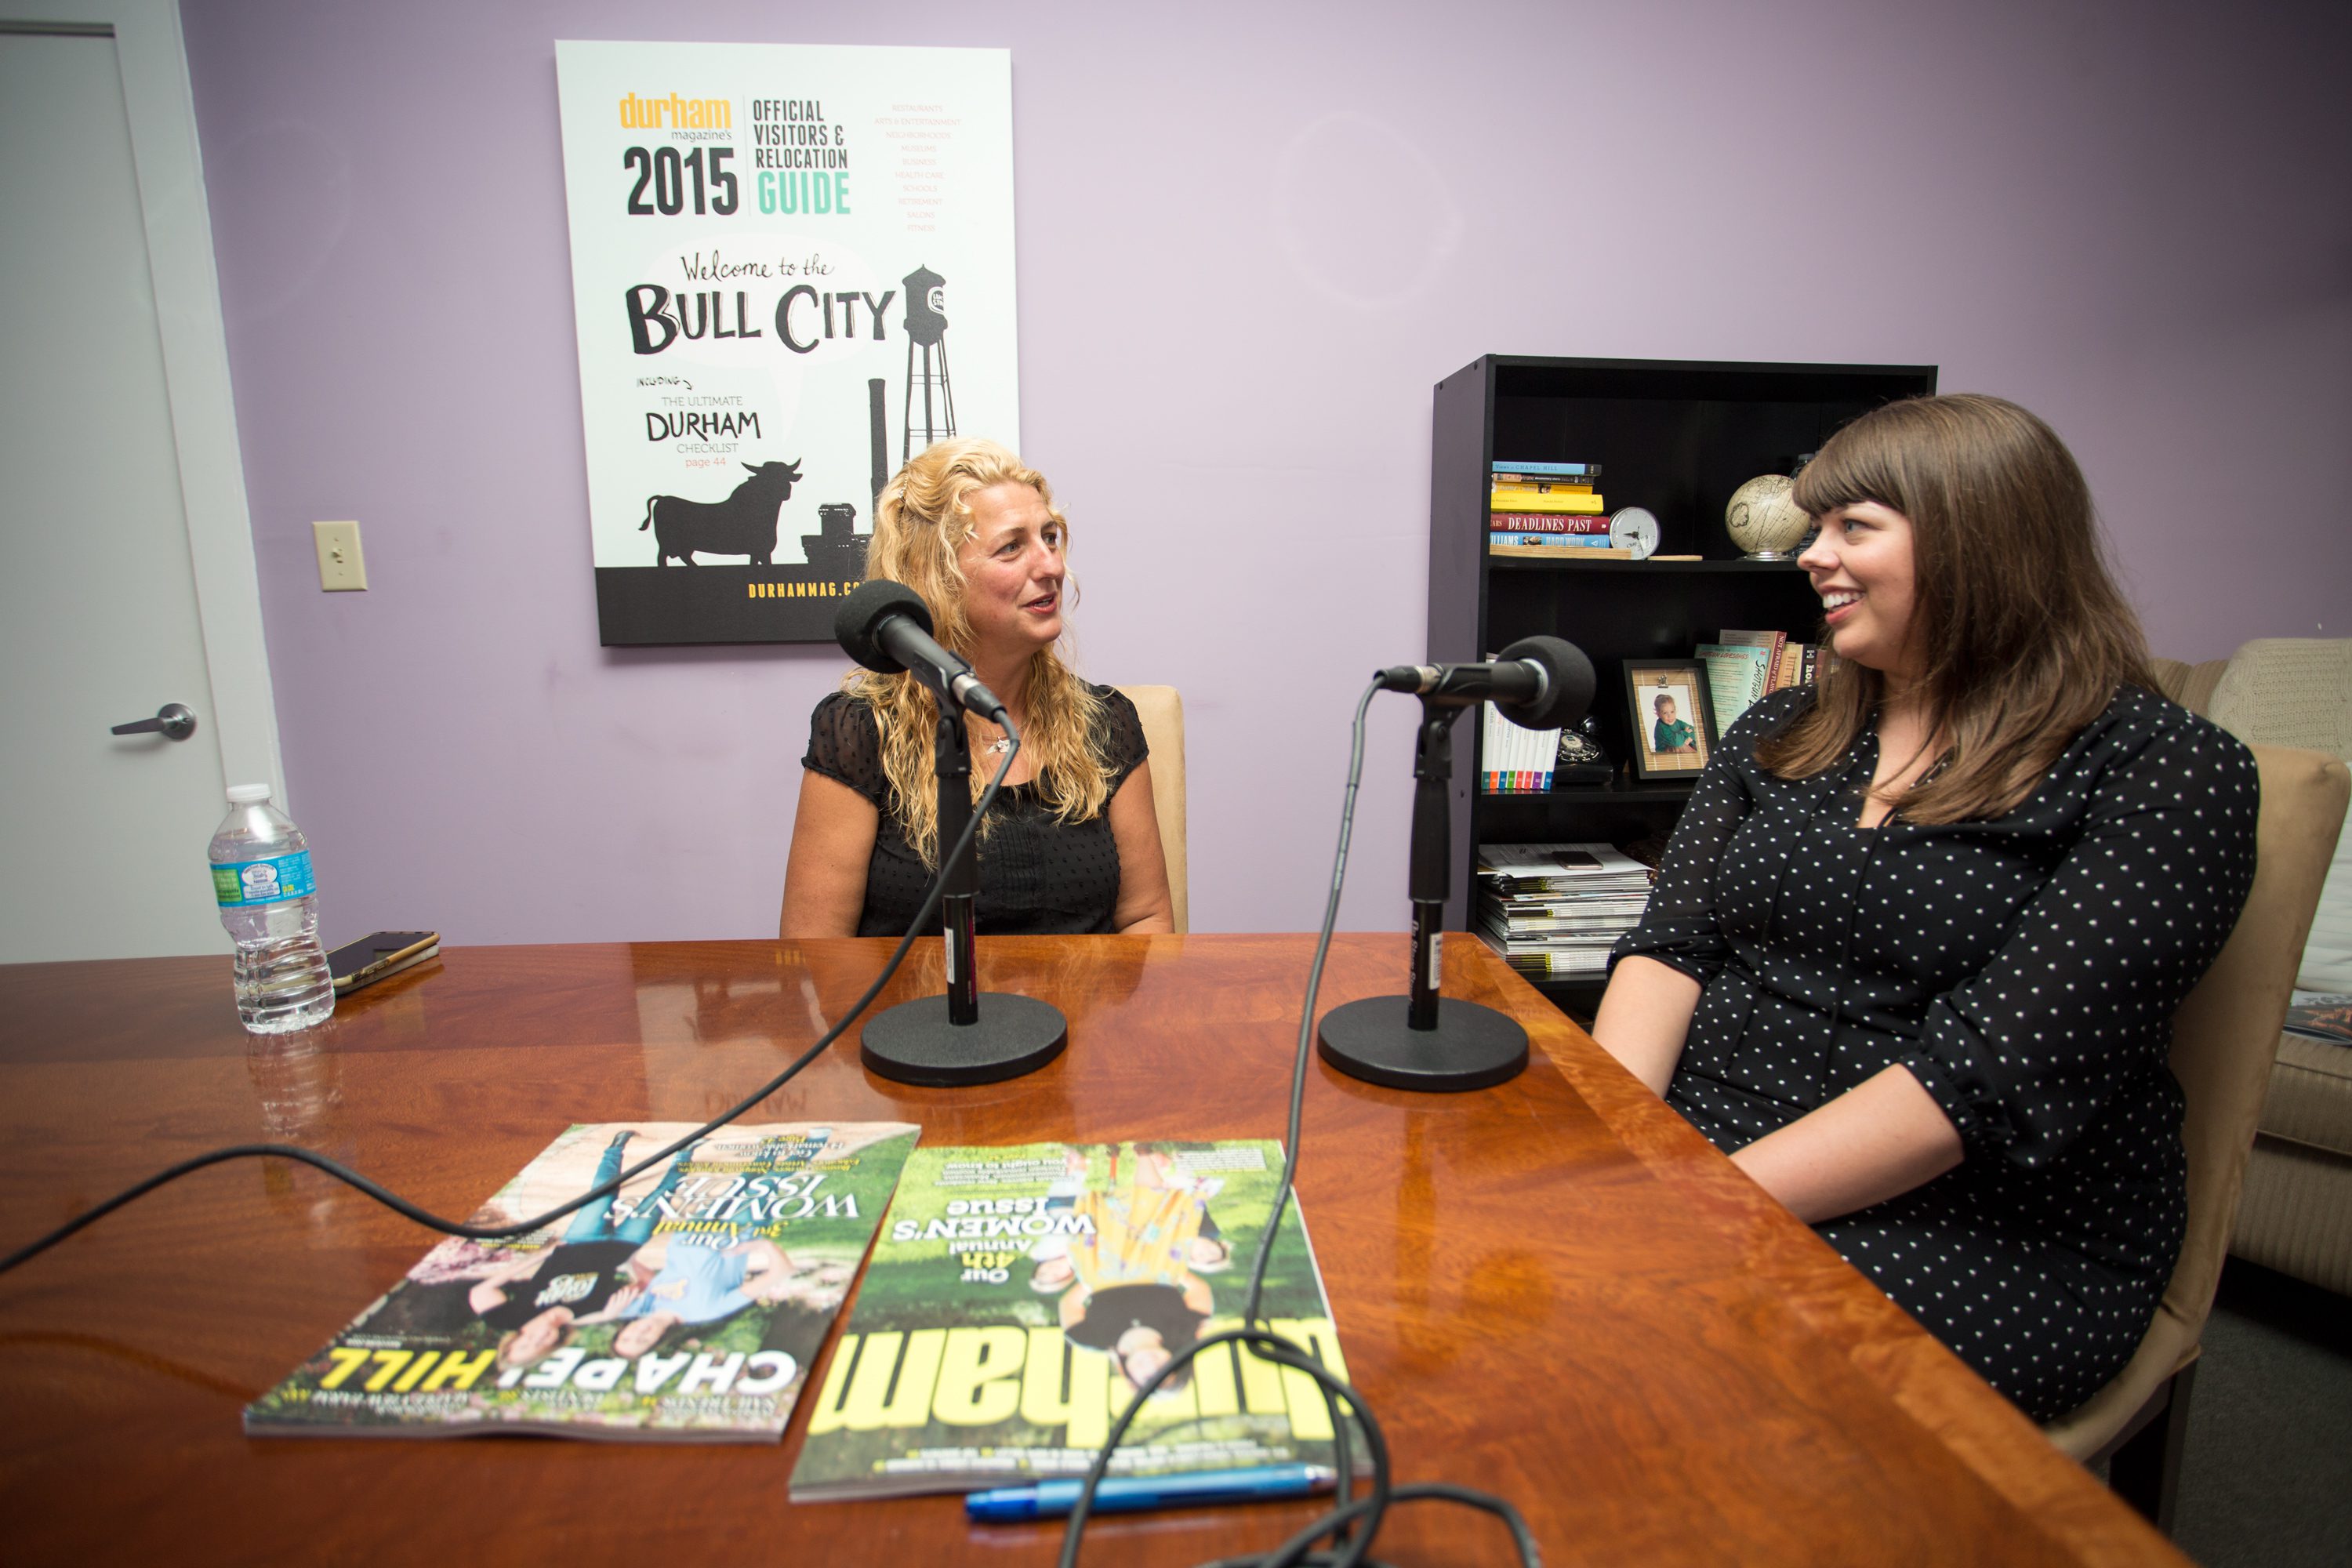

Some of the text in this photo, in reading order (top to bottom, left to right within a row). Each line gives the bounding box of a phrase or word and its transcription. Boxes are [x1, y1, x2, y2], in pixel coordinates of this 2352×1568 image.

[619, 93, 732, 129] durham
[753, 100, 824, 122] OFFICIAL
[671, 130, 732, 143] magazine's
[753, 125, 844, 146] VISITORS &
[756, 148, 848, 169] RELOCATION
[624, 147, 739, 216] 2015
[757, 171, 851, 215] GUIDE
[681, 249, 835, 282] Welcome to the
[626, 284, 897, 355] BULL CITY
[661, 396, 743, 406] THE ULTIMATE
[646, 411, 761, 442] DURHAM
[677, 443, 739, 453] CHECKLIST
[685, 457, 726, 468] page 44
[1508, 517, 1564, 531] DEADLINES
[1568, 519, 1592, 532] PAST
[671, 1175, 829, 1200] ISSUE
[946, 1196, 1051, 1216] Issue
[892, 1214, 1097, 1241] WOMEN'S
[949, 1239, 1033, 1254] Annual
[962, 1252, 1017, 1269] 4th
[960, 1267, 1009, 1285] Our
[320, 1347, 496, 1390] HILL
